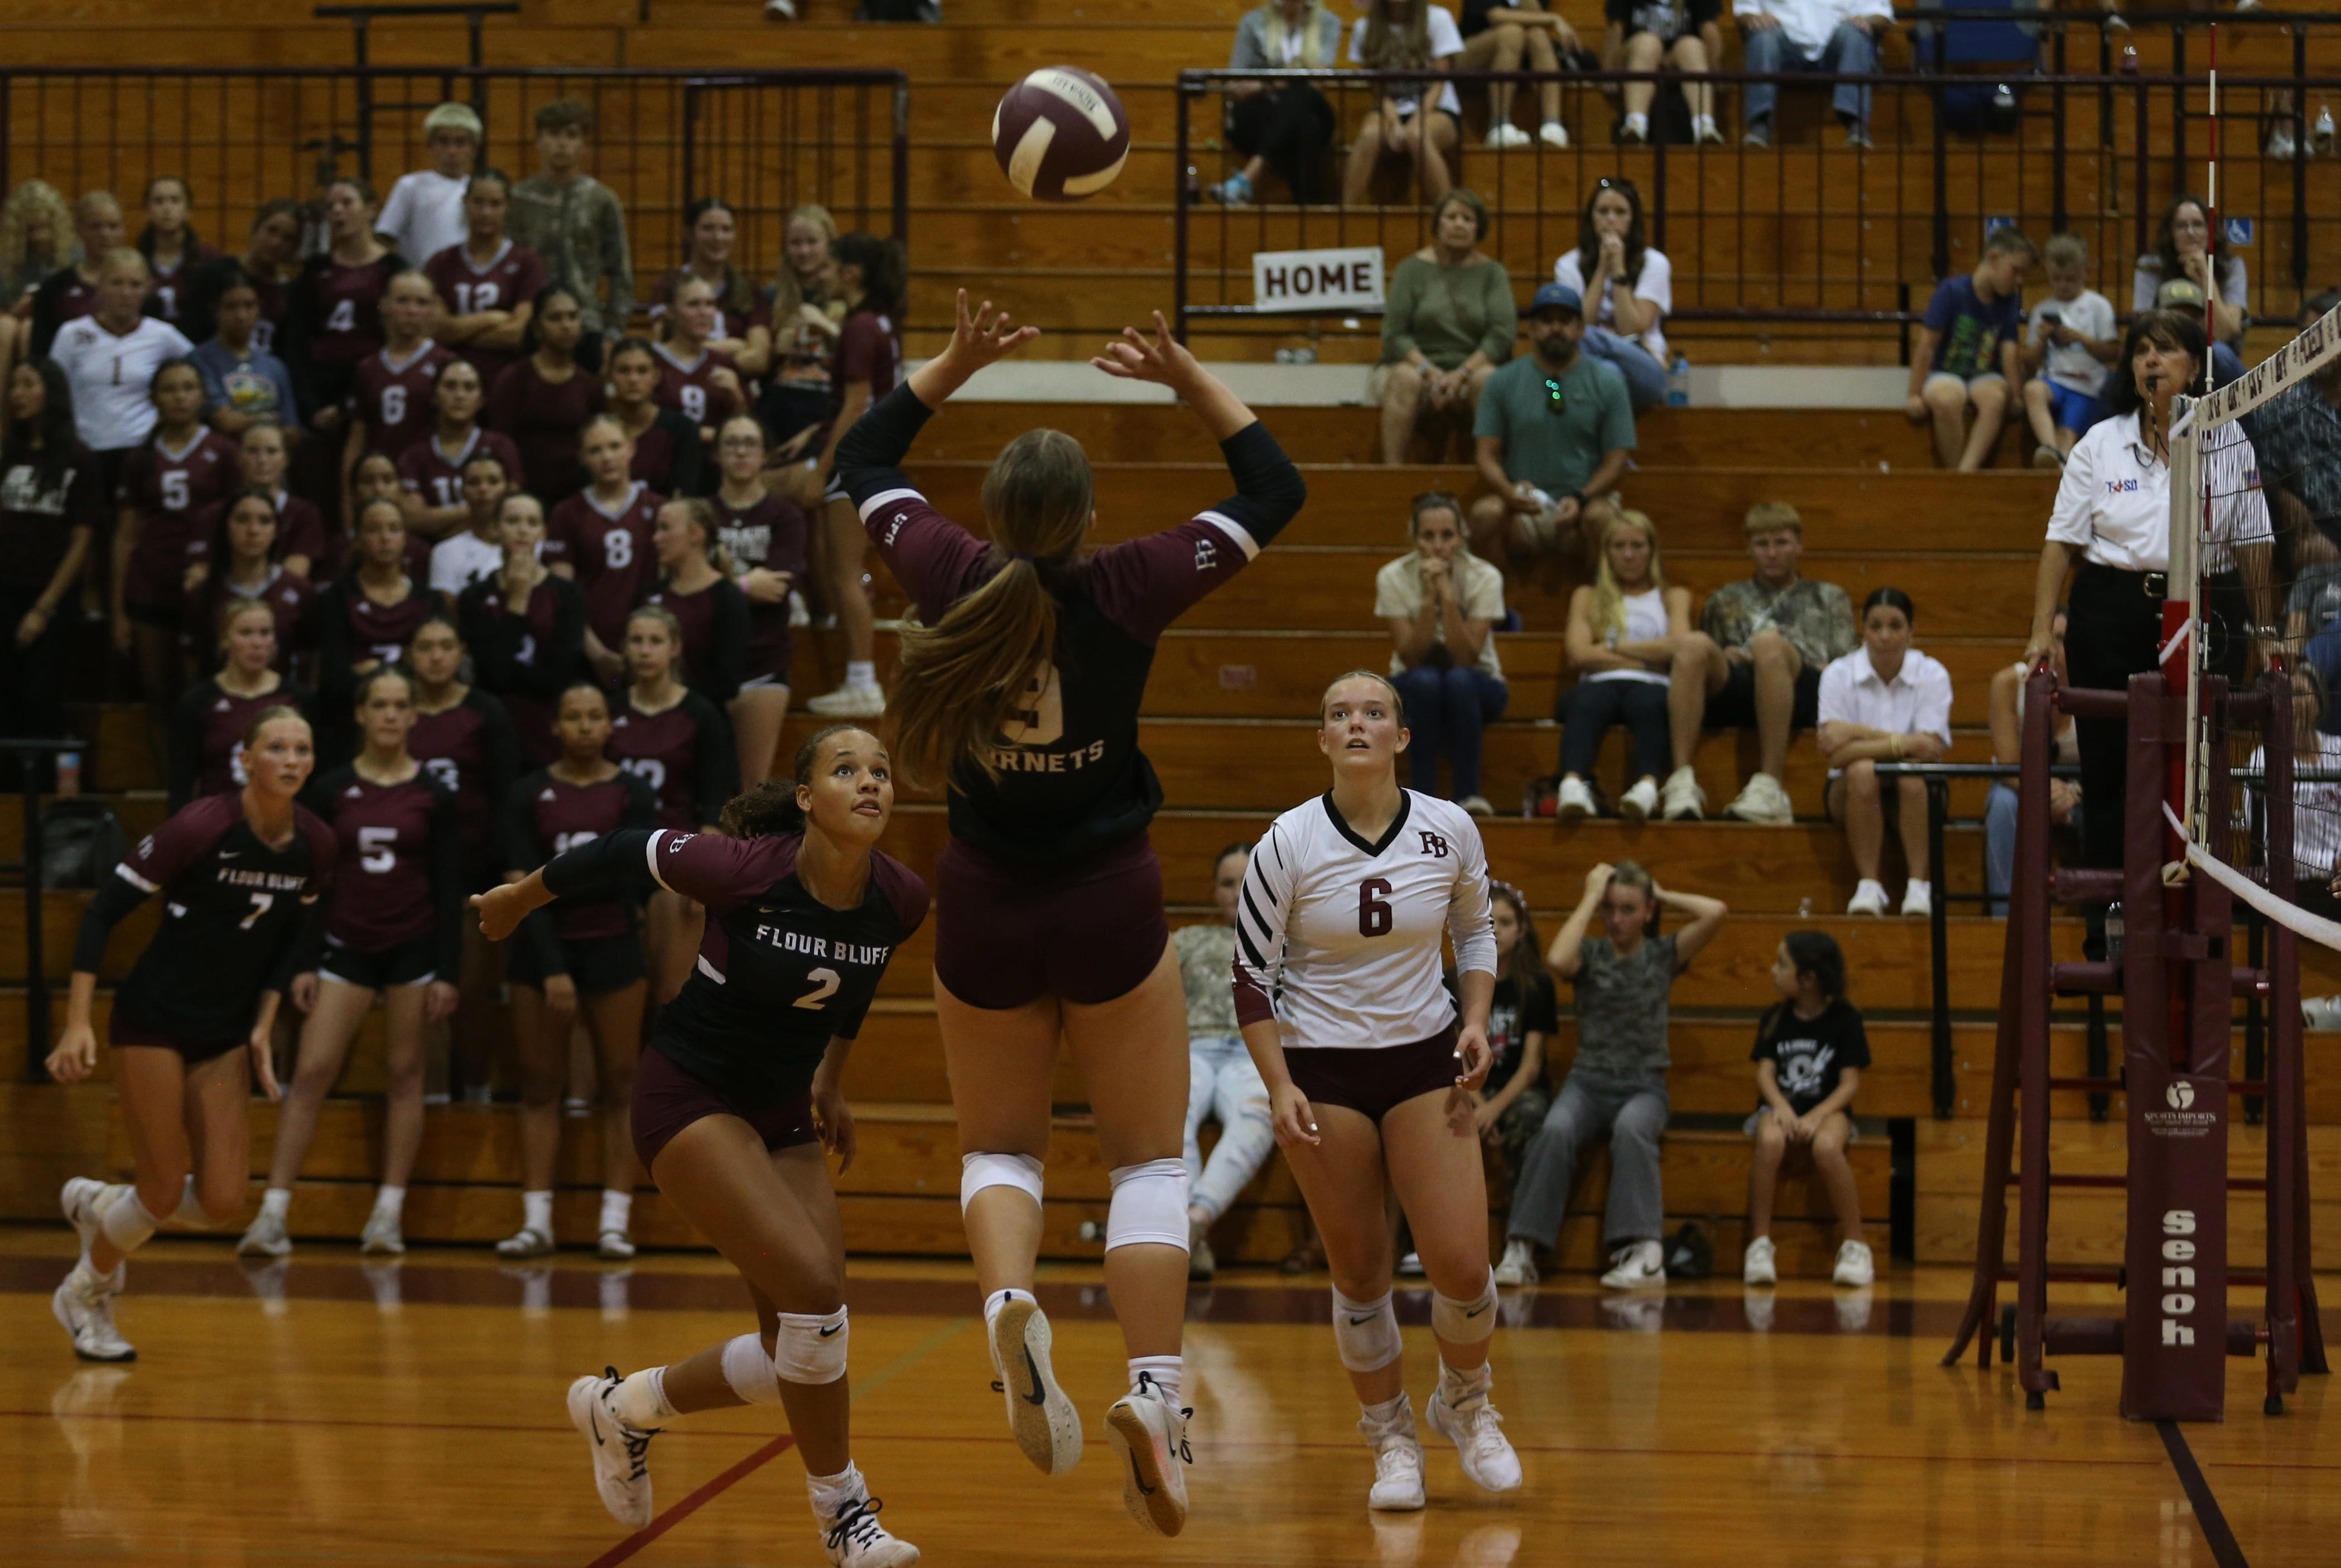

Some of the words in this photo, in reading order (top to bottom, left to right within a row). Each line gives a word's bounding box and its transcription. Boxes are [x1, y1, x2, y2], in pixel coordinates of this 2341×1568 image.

[454, 282, 500, 315] 12
[1266, 261, 1372, 297] HOME
[326, 298, 357, 331] 4
[112, 356, 123, 385] 1
[381, 385, 408, 425] 6
[161, 469, 190, 510] 5
[604, 528, 633, 570] 8
[358, 827, 398, 874] 5
[1418, 831, 1448, 858] FB
[238, 892, 274, 930] 7
[1359, 878, 1392, 937] 6
[756, 924, 827, 958] FLOUR
[834, 941, 889, 966] BLUFF
[792, 967, 841, 1010] 2
[2144, 1112, 2176, 1122] SPORTS
[2178, 1112, 2217, 1122] IMPORTS
